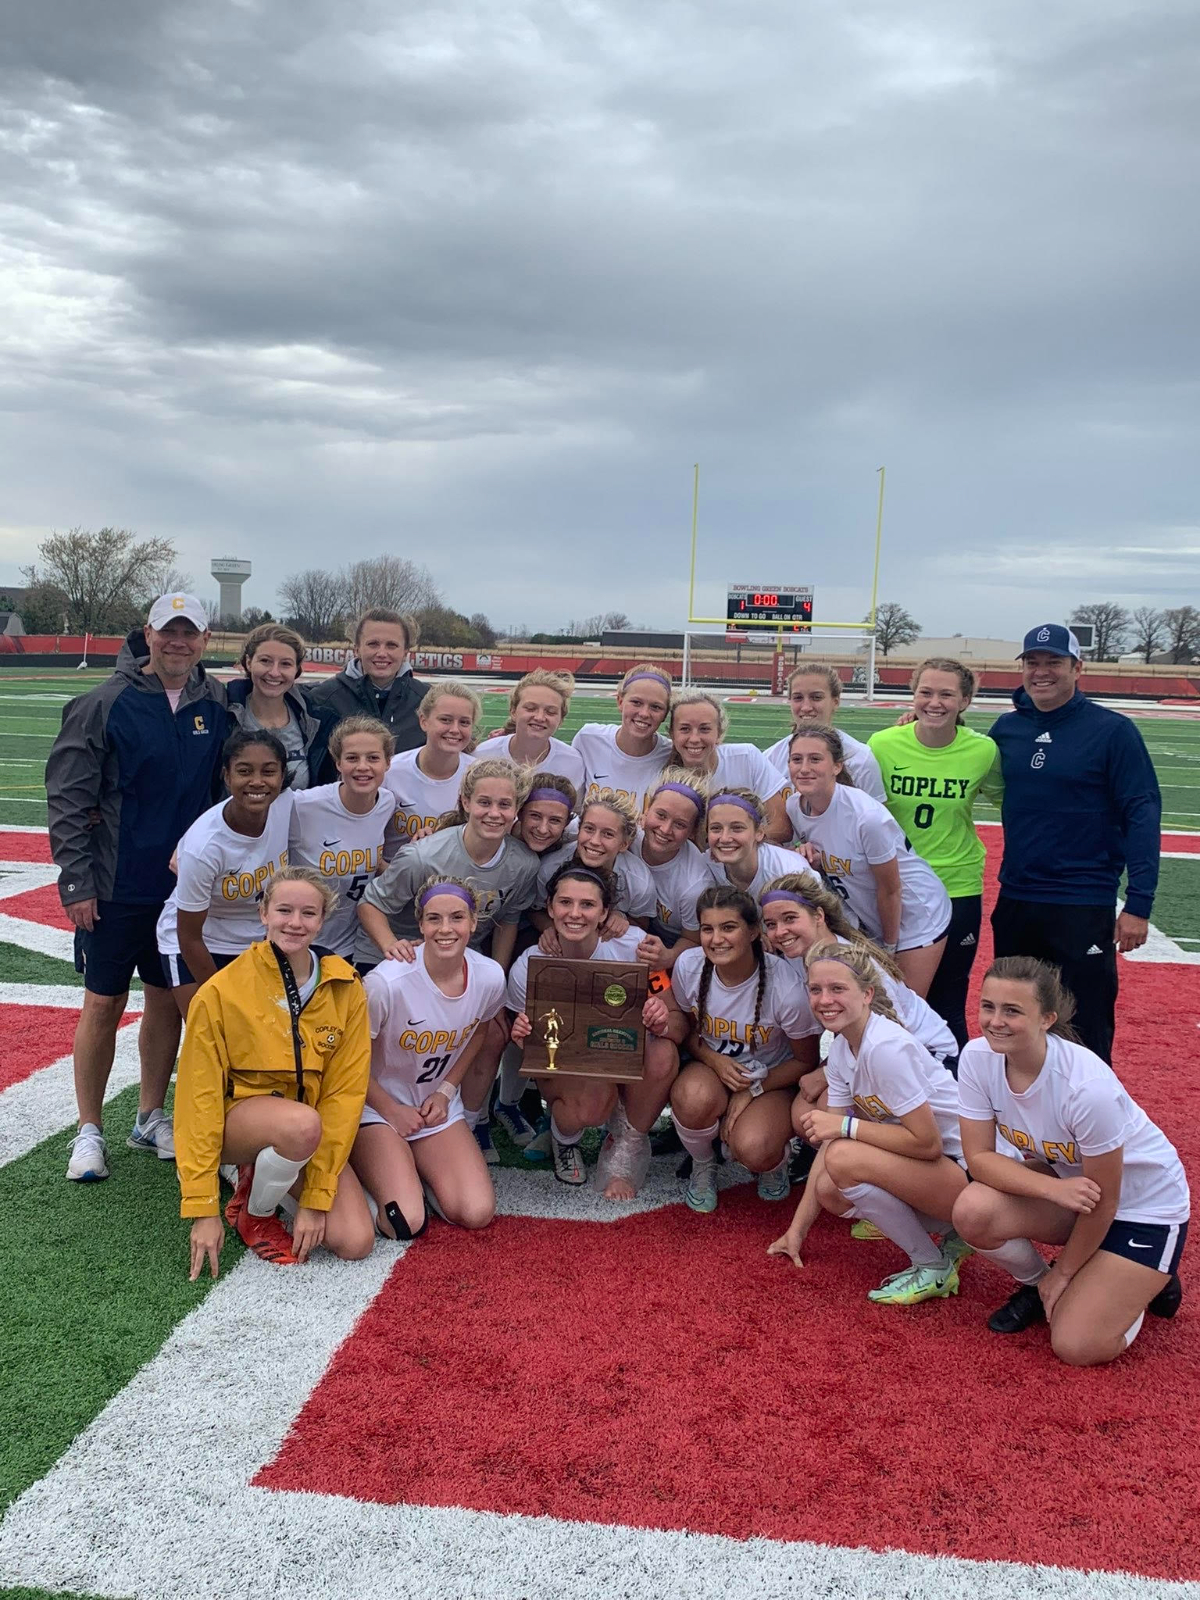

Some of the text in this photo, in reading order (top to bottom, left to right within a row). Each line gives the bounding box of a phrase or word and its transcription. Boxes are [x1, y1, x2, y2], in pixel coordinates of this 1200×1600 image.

[172, 597, 185, 610] C
[803, 602, 811, 612] 4
[304, 647, 354, 664] BOBCA
[406, 652, 463, 668] LETICS
[194, 715, 205, 731] C
[891, 774, 970, 799] COPLEY
[394, 811, 438, 837] COP
[914, 803, 935, 829] 0
[222, 850, 288, 901] COPLE
[346, 875, 368, 902] 5
[648, 976, 664, 994] C
[416, 1054, 452, 1084] 21
